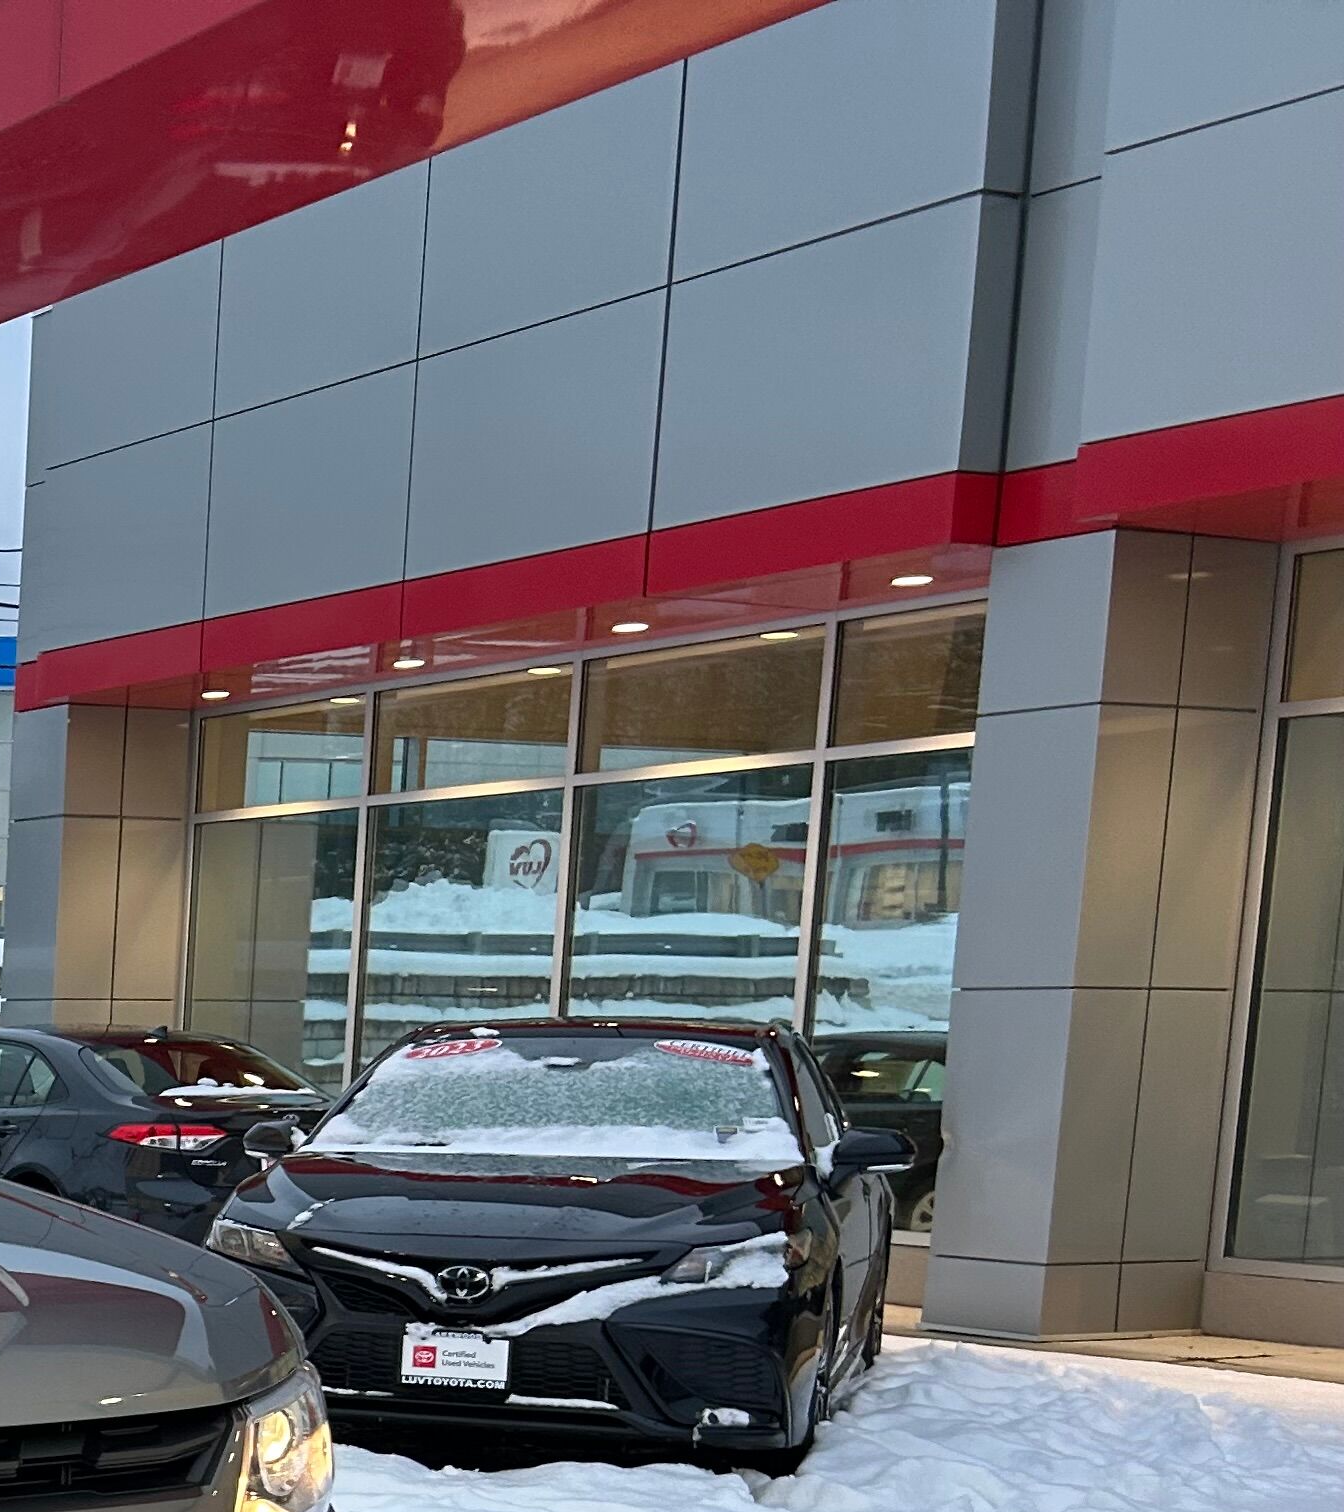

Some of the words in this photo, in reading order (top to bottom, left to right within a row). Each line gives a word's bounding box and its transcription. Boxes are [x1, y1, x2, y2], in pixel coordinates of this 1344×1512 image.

[441, 1349, 477, 1359] Certified
[441, 1359, 461, 1367] Used
[463, 1360, 495, 1369] Vehicles
[401, 1375, 506, 1390] LUVTOYOTA.COM
